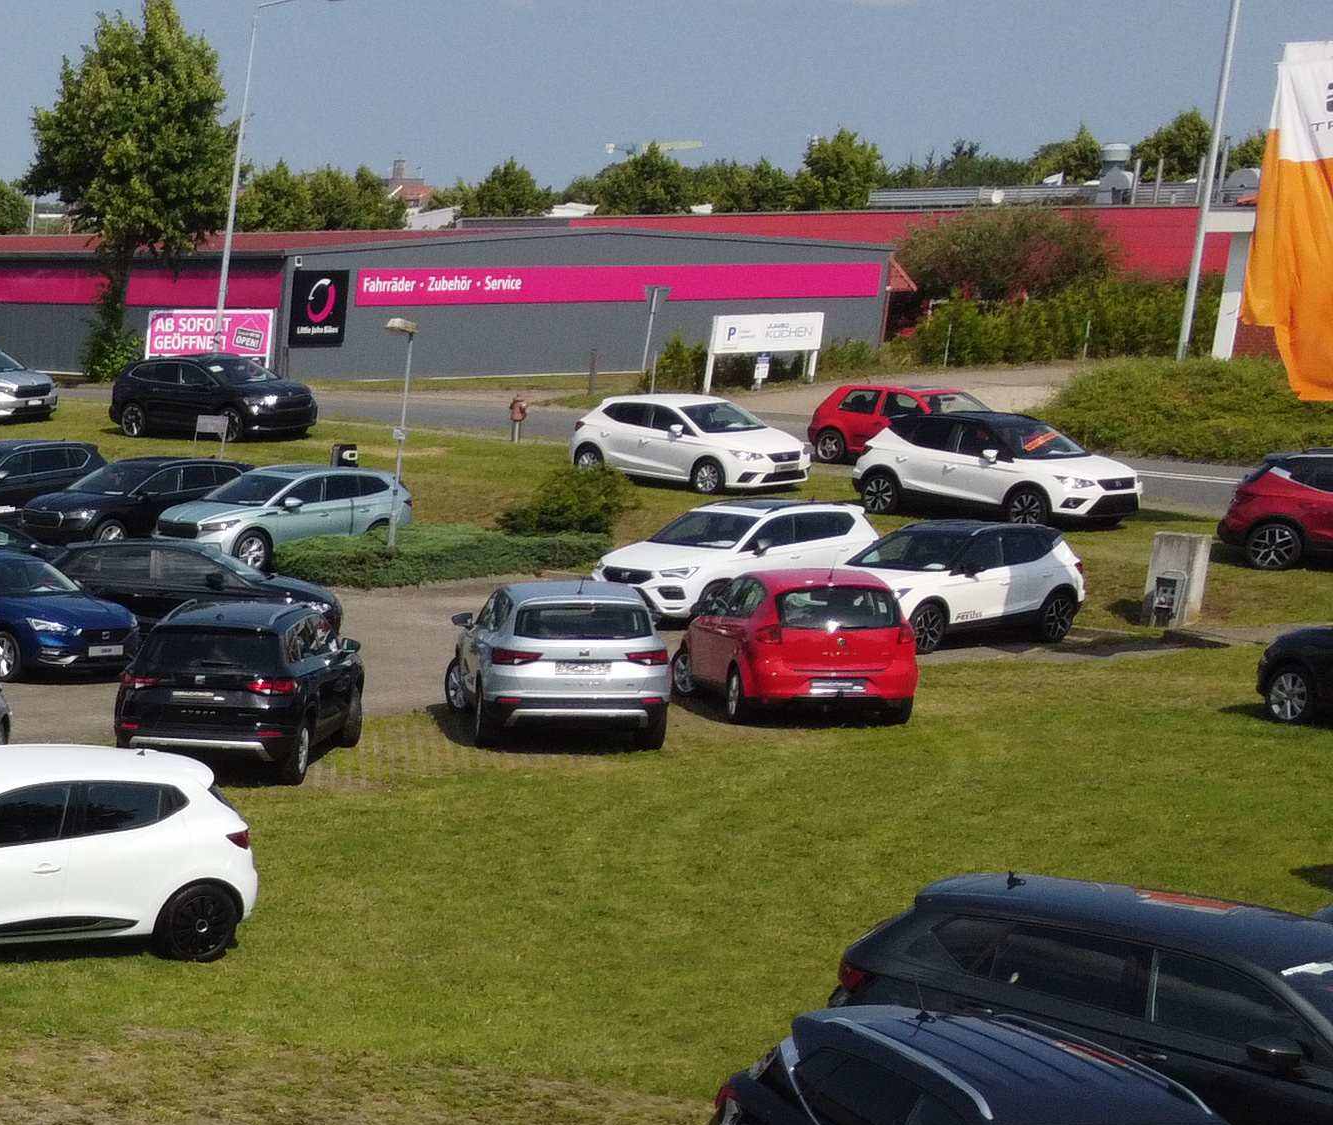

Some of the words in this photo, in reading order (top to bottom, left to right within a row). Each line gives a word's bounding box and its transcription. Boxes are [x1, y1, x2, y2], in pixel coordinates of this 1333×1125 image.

[363, 276, 416, 292] Fahrräder
[427, 275, 472, 291] Zubehör
[484, 274, 522, 290] Service
[155, 317, 175, 333] AB
[235, 336, 261, 348] OPEN!
